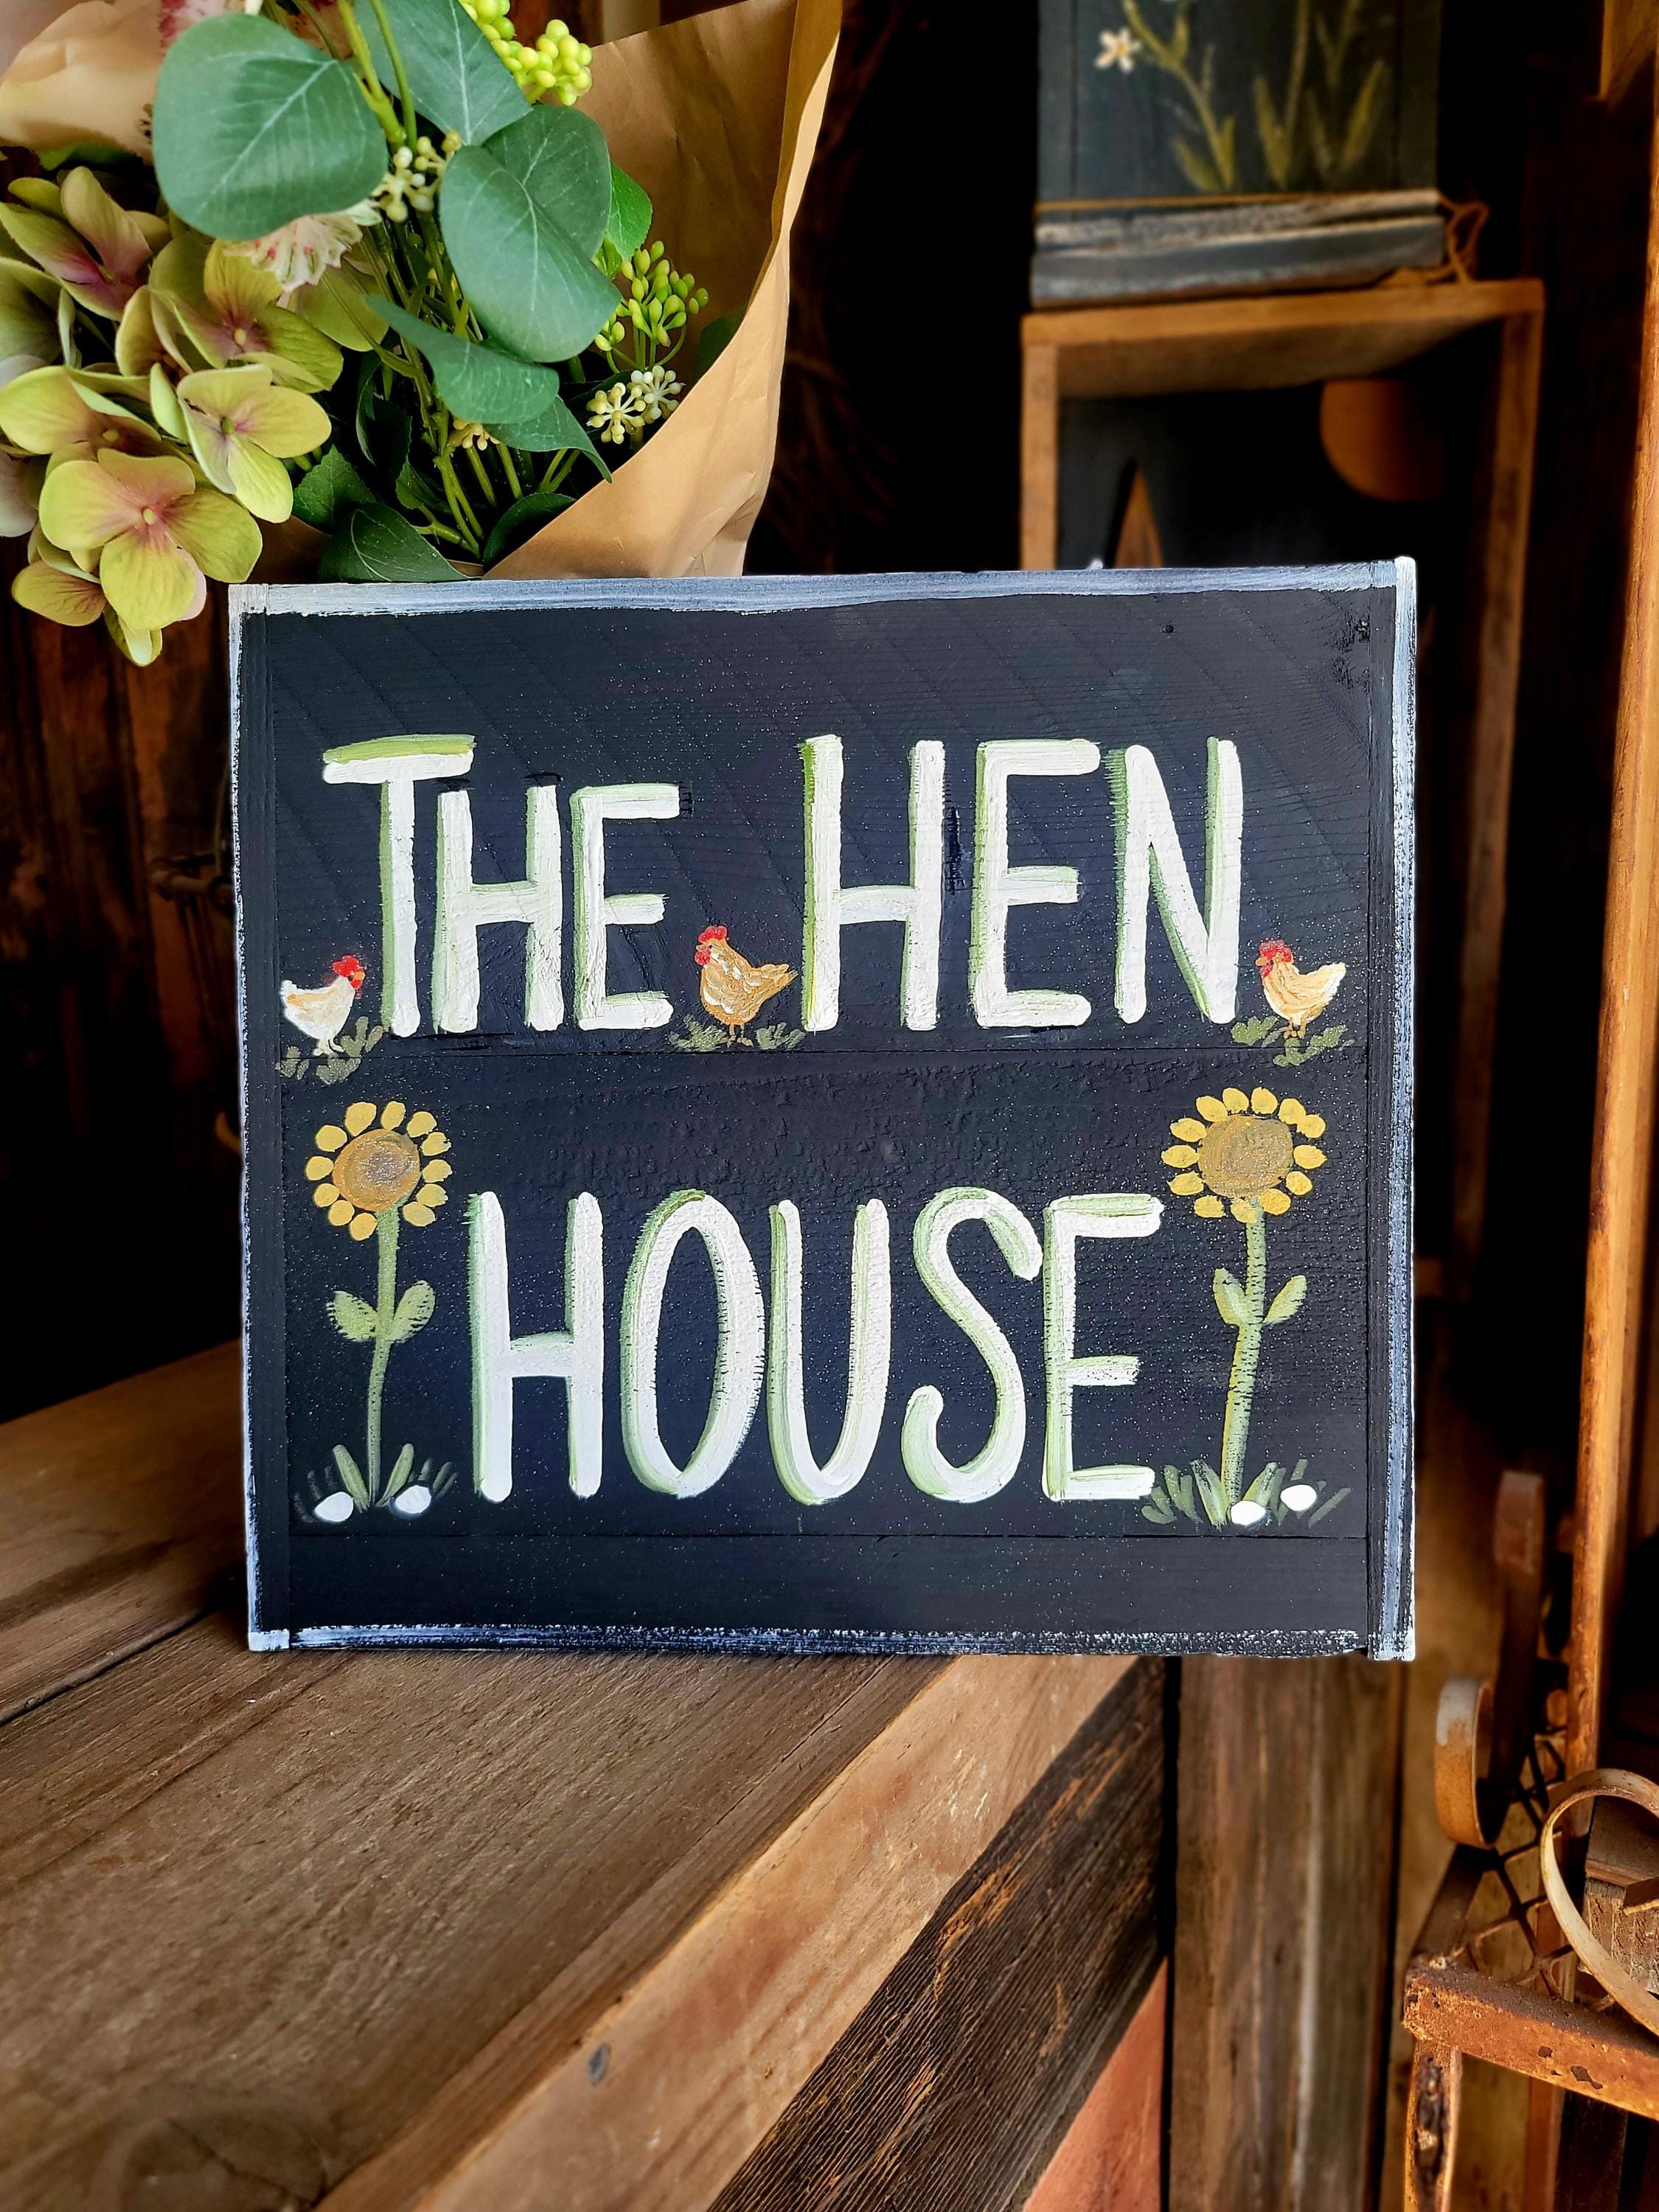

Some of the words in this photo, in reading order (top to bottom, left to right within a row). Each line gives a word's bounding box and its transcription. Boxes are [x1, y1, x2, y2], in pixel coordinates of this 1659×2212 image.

[322, 733, 681, 1037] THE
[801, 734, 1243, 1032] HEN
[467, 1188, 1164, 1506] HOUSE
